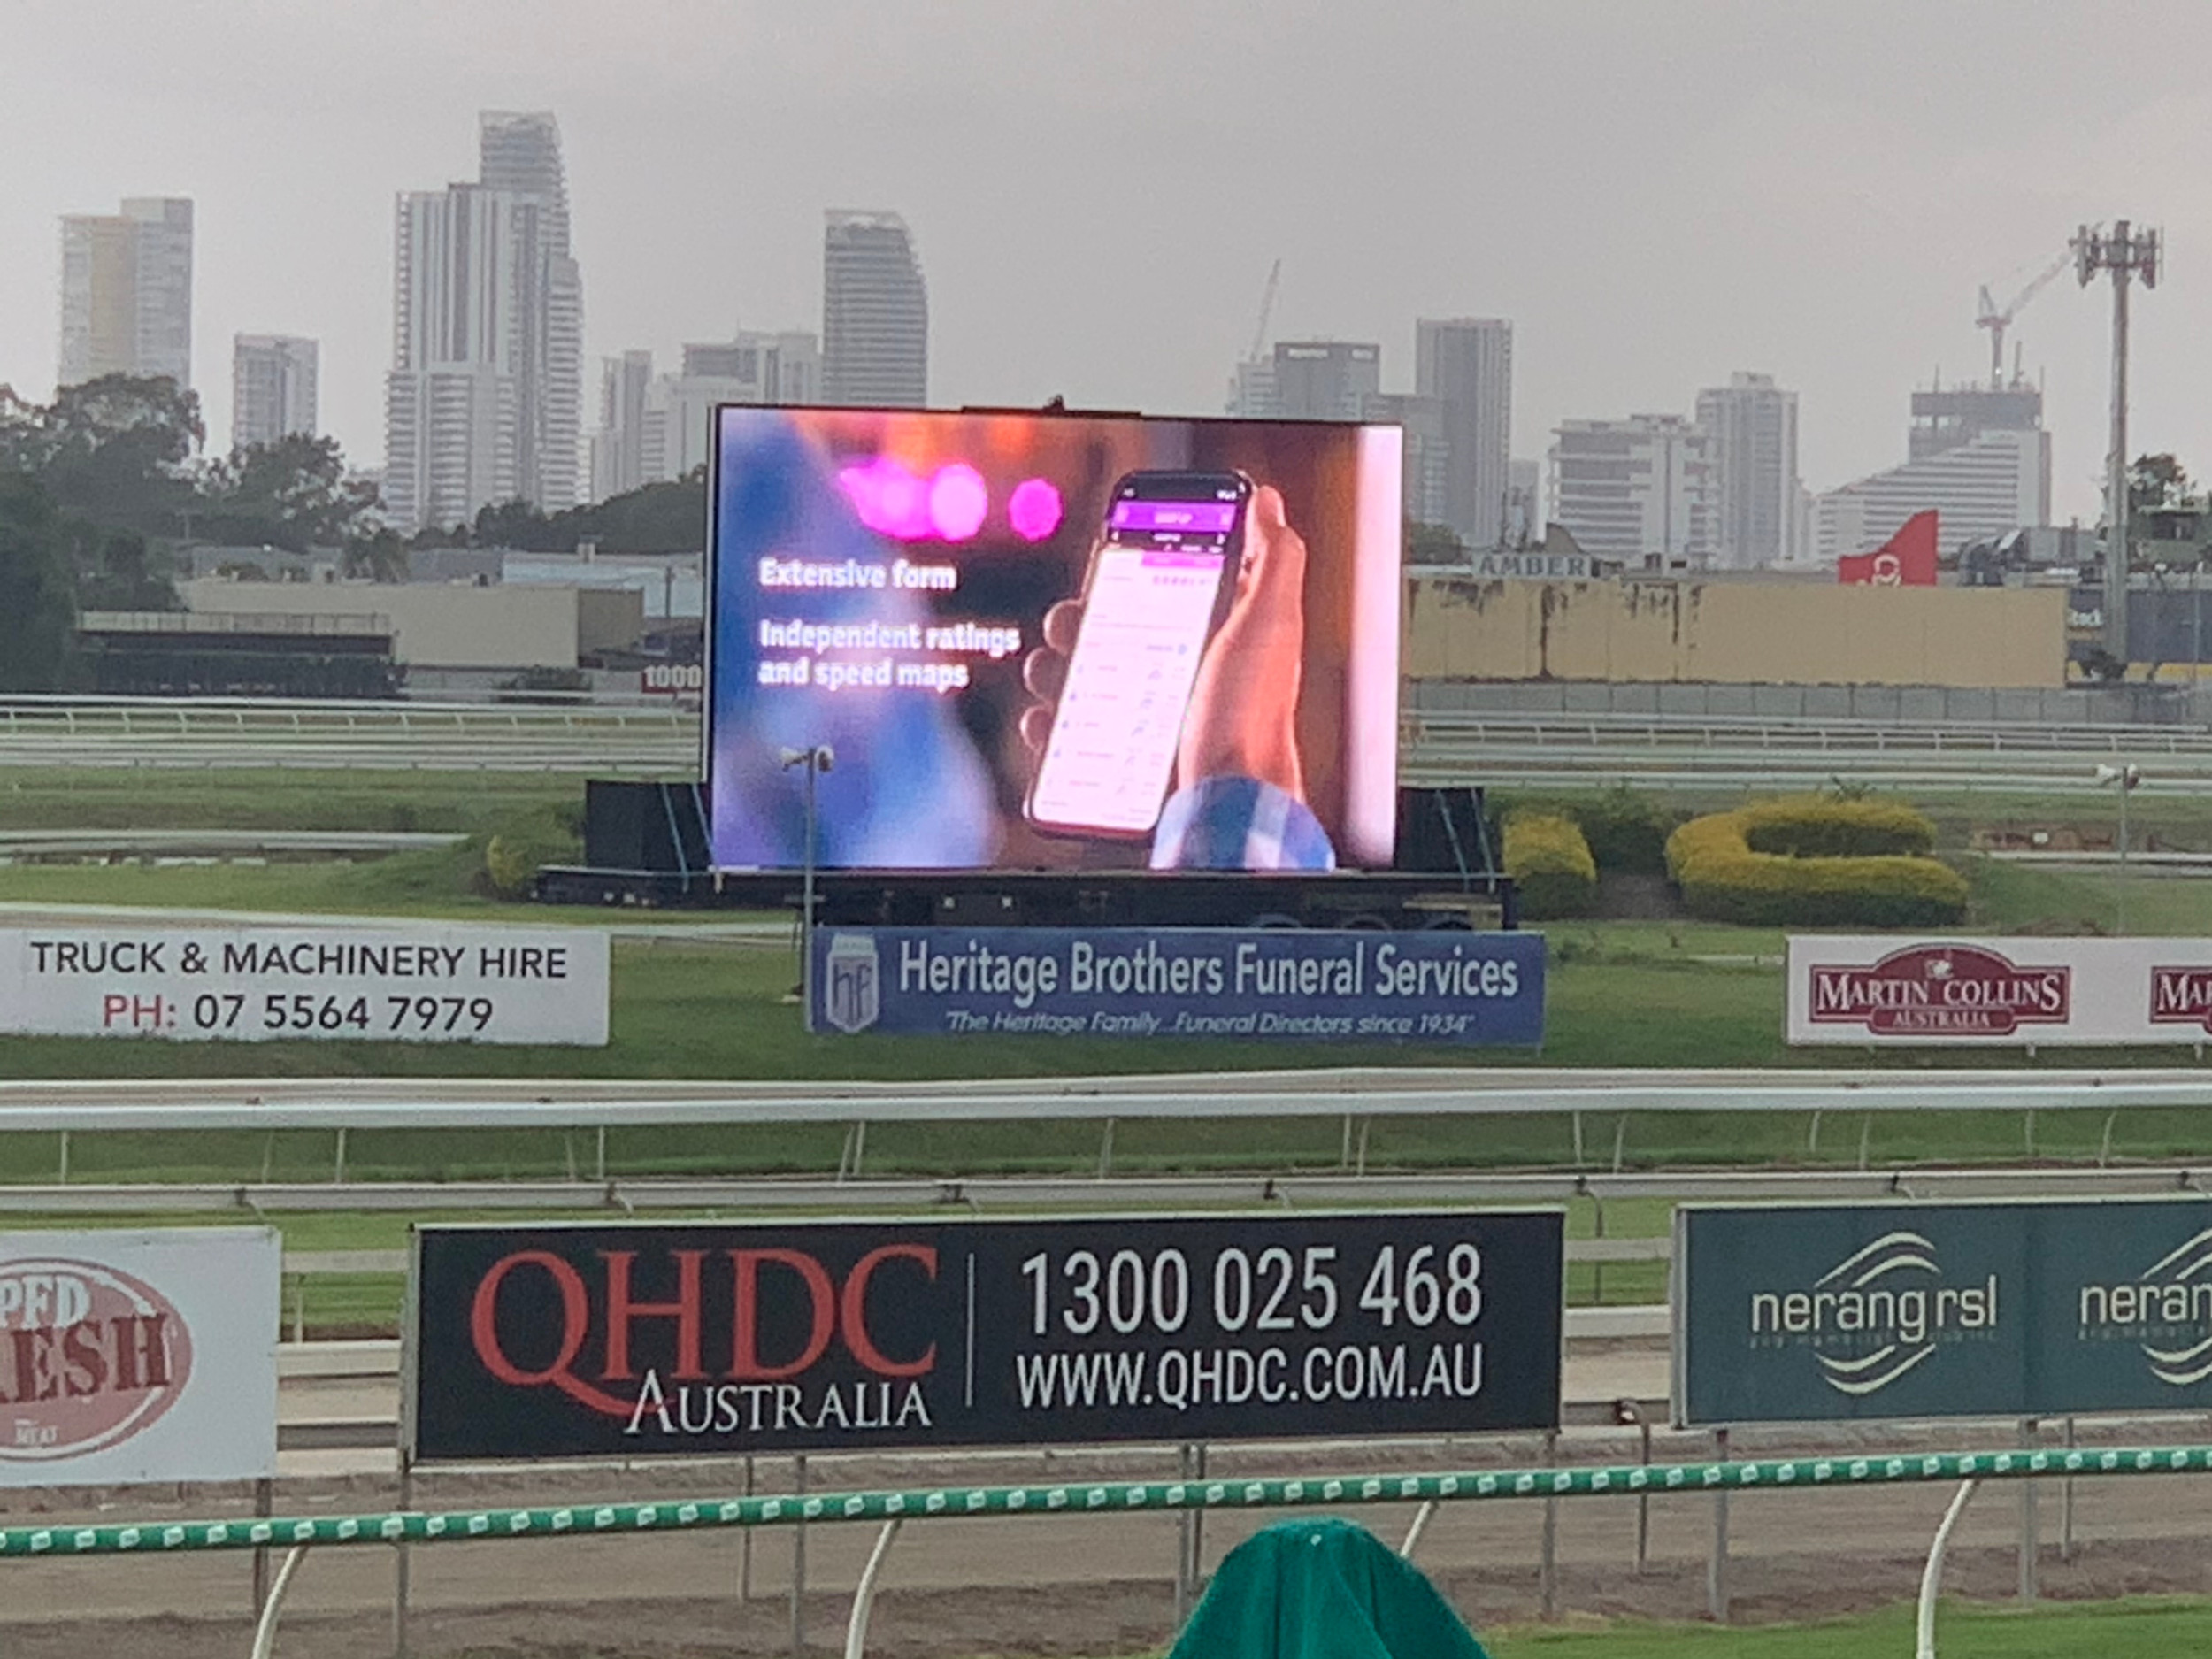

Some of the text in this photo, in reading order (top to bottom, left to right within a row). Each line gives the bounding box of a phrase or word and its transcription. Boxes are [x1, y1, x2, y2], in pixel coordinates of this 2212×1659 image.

[758, 557, 958, 589] Extensive form
[1479, 555, 1585, 575] AMBER
[759, 619, 1022, 657] Independent ratings
[644, 664, 702, 687] 1000
[758, 656, 970, 693] and speed maps
[30, 941, 566, 979] TRUCK & MACHINERY HIRE
[899, 938, 1519, 1009] Heritage Brothers Funeral Services
[1817, 972, 2061, 1012] MARTIN COLLINS
[104, 994, 493, 1032] PH: 07 5564 7979
[993, 1011, 1087, 1036] Heritage
[1259, 1014, 1352, 1034] Directors
[1357, 1014, 1413, 1034] since
[1893, 1011, 1991, 1028] AUSTRALIA
[1021, 1243, 1483, 1334] 1300 025 468
[1751, 1290, 1926, 1343] nerang
[1936, 1274, 1997, 1327] rsl
[471, 1244, 938, 1417] QHDC
[0, 1313, 170, 1403] ESH
[1017, 1341, 1483, 1410] WWW.QHDC.COM.AU
[625, 1369, 933, 1435] AUSTRALIA
